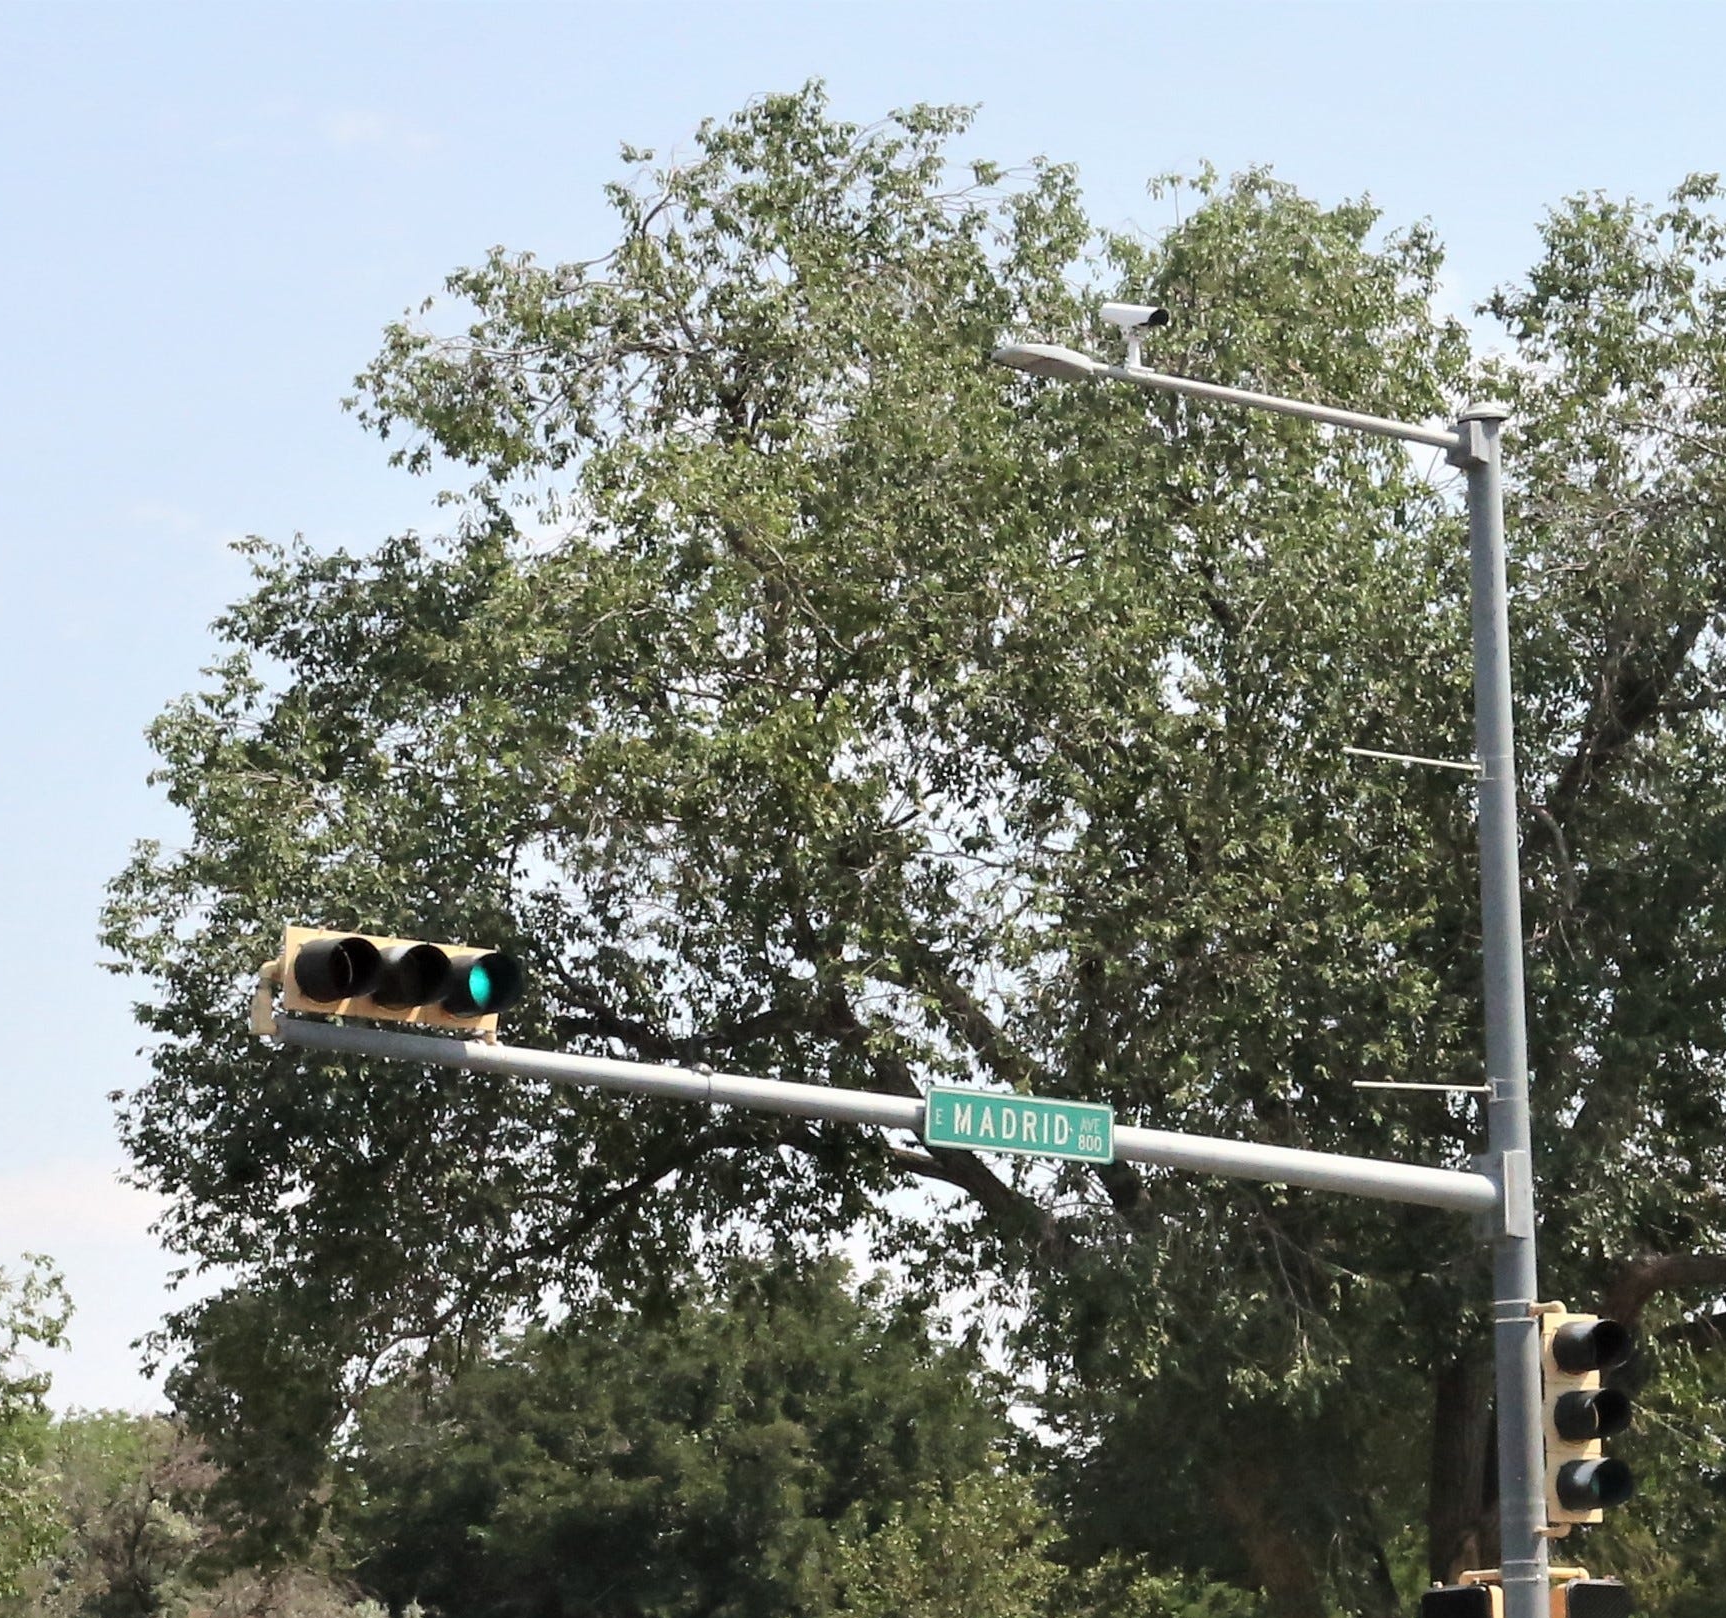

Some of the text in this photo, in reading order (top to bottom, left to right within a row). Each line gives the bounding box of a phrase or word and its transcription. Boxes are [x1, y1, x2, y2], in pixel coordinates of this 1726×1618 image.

[934, 1103, 1101, 1145] E MADRID AVE
[1078, 1134, 1103, 1153] 800
